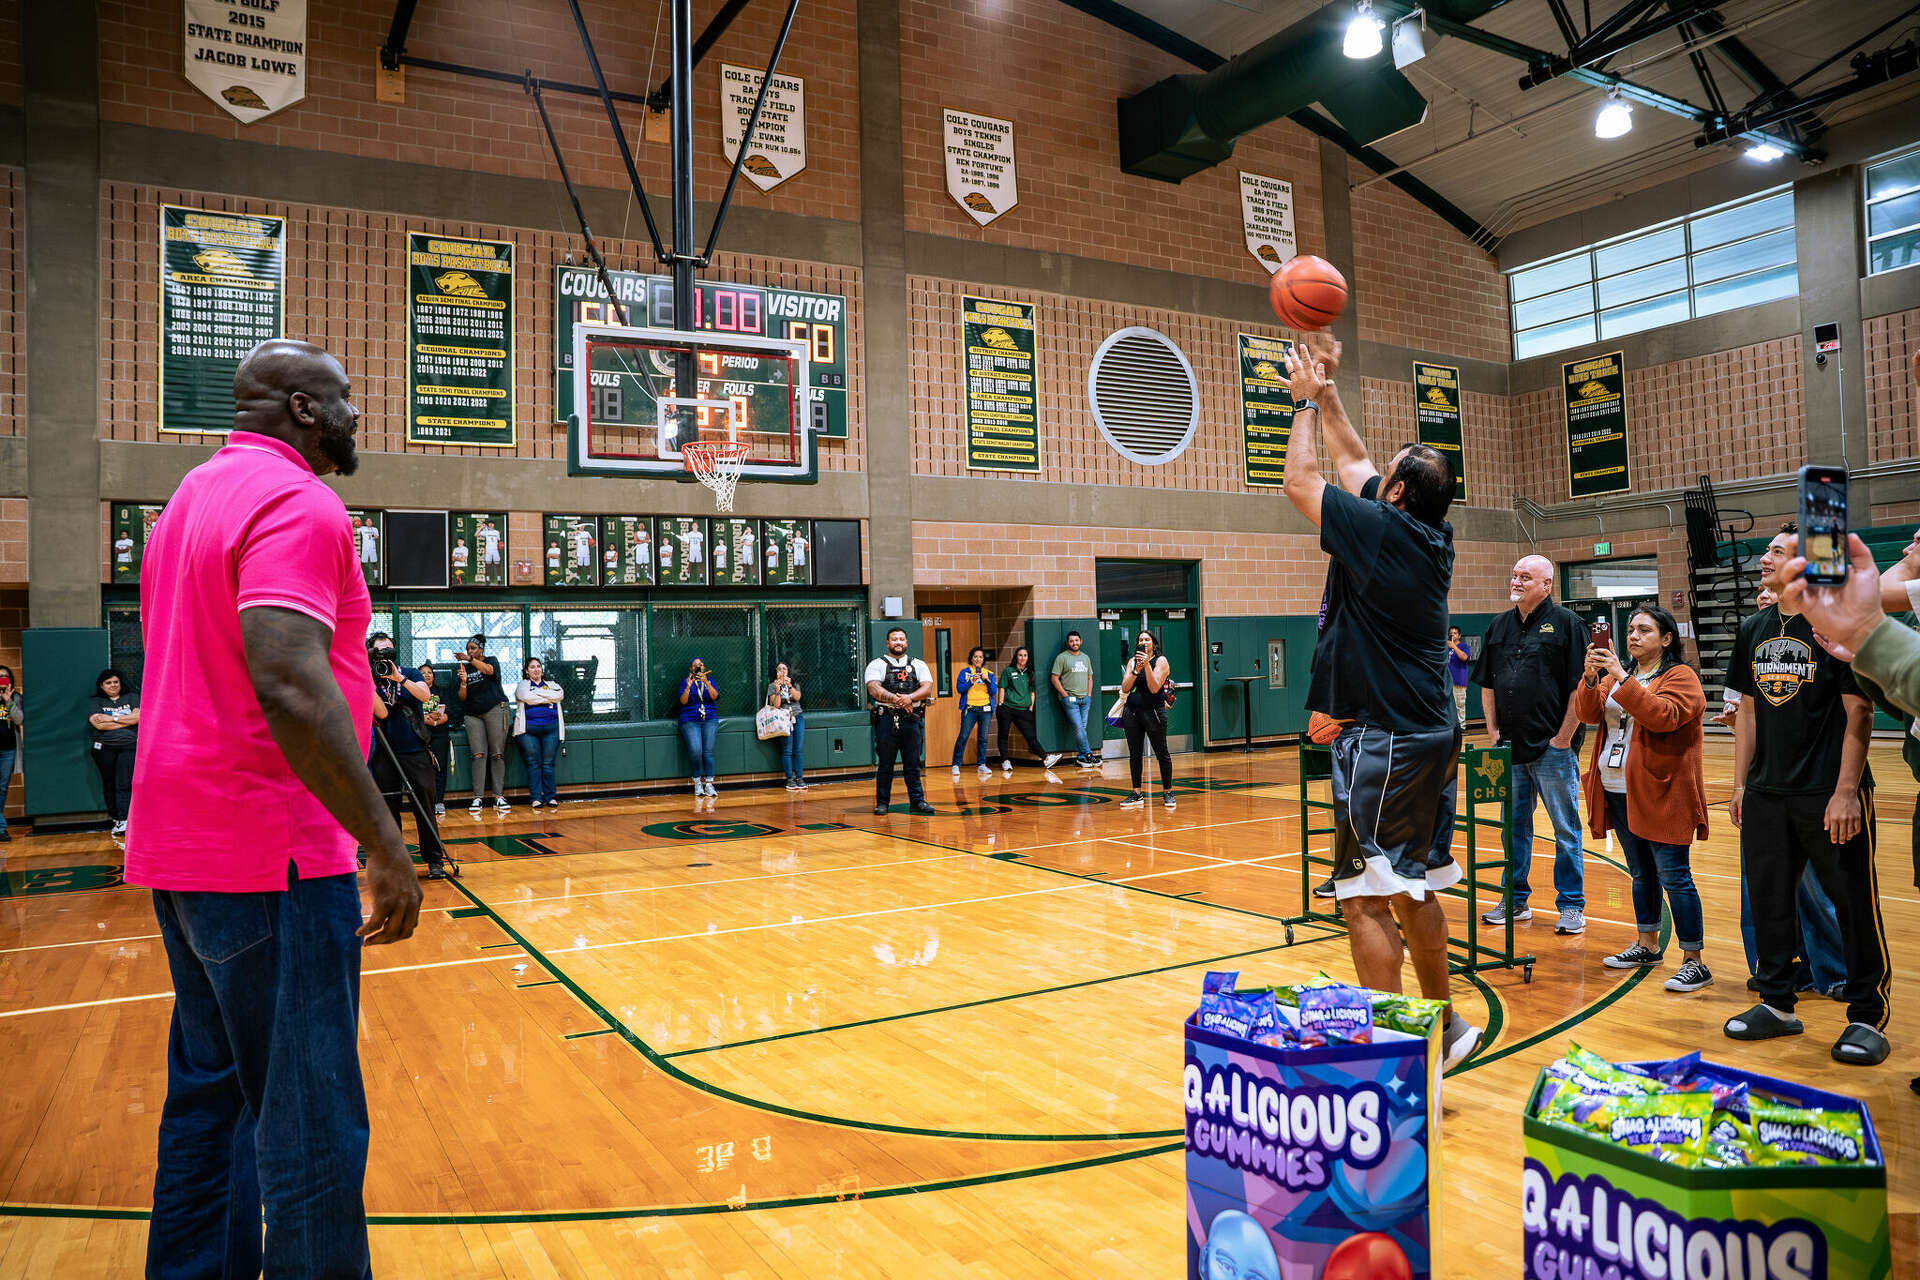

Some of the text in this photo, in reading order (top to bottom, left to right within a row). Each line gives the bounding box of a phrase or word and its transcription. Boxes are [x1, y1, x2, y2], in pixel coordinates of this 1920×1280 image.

[229, 11, 265, 28] 2015
[188, 23, 303, 54] STATE CHAMPION
[195, 48, 297, 75] JACOB LOWE
[725, 71, 751, 82] COLE
[770, 101, 796, 112] FIELD
[761, 111, 789, 122] STATE
[946, 114, 1009, 133] COLE COUGARS
[726, 137, 737, 145] 100
[759, 132, 785, 143] EVANS
[953, 127, 1001, 143] BOYS TENNIS
[964, 139, 994, 151] SINGLES
[948, 146, 1011, 164] STATE CHAMPION
[972, 161, 1003, 173] FORTUNE
[1242, 176, 1290, 193] COLE COUGARS
[1246, 195, 1288, 211] TRACK FIELD
[1266, 208, 1283, 218] STATE
[185, 213, 263, 235] COUGAR
[1254, 215, 1282, 226] CHAMPION
[166, 225, 280, 250] BOYS BASKETBALL
[428, 240, 497, 259] COUGAR
[411, 251, 511, 274] BOYS BASKETBALL
[180, 274, 267, 288] AREA CHAMPIONS
[418, 295, 440, 303] REGION
[472, 299, 504, 308] CHAMPIONS
[768, 292, 841, 322] VISITOR
[975, 301, 1023, 318] COUGAR
[172, 321, 191, 331] 2003
[193, 323, 212, 333] 2004
[255, 328, 274, 337] 2007
[452, 318, 469, 326] 2010
[470, 319, 486, 328] 2011
[487, 320, 504, 329] 2012
[452, 327, 469, 336] 2020
[470, 329, 486, 338] 2021
[487, 330, 504, 339] 2022
[193, 335, 212, 345] 2011
[214, 337, 233, 347] 2012
[235, 338, 253, 348] 2013
[1248, 338, 1285, 354] COUGAR
[172, 346, 233, 359] 2019 2020 2021
[421, 345, 502, 357] REGIONAL CHAMPIONS
[972, 347, 1028, 358] DISTRICT CHAMPIONS
[487, 360, 504, 368] 2012
[722, 355, 759, 370] PERIOD
[1573, 357, 1613, 374] COUGAR
[452, 367, 469, 376] 2021
[470, 368, 486, 377] 2022
[1568, 365, 1619, 384] BOYS TRACK
[472, 389, 504, 397] CHAMPIONS
[723, 382, 756, 397] FOULS
[452, 397, 469, 406] 2021
[470, 398, 486, 407] 2022
[453, 419, 496, 427] CHAMPIONS
[434, 427, 451, 436] 2021
[1001, 426, 1031, 434] CHAMPIONS
[121, 508, 128, 519] 0
[457, 517, 464, 527] 5
[549, 519, 559, 529] 10
[607, 521, 616, 531] 11
[662, 521, 671, 531] 13
[715, 523, 725, 532] 23
[624, 521, 636, 583] BRAXTON
[732, 523, 744, 583] DOWNING
[1596, 543, 1609, 555] EXIT
[1193, 1119, 1326, 1186] GUMMIES
